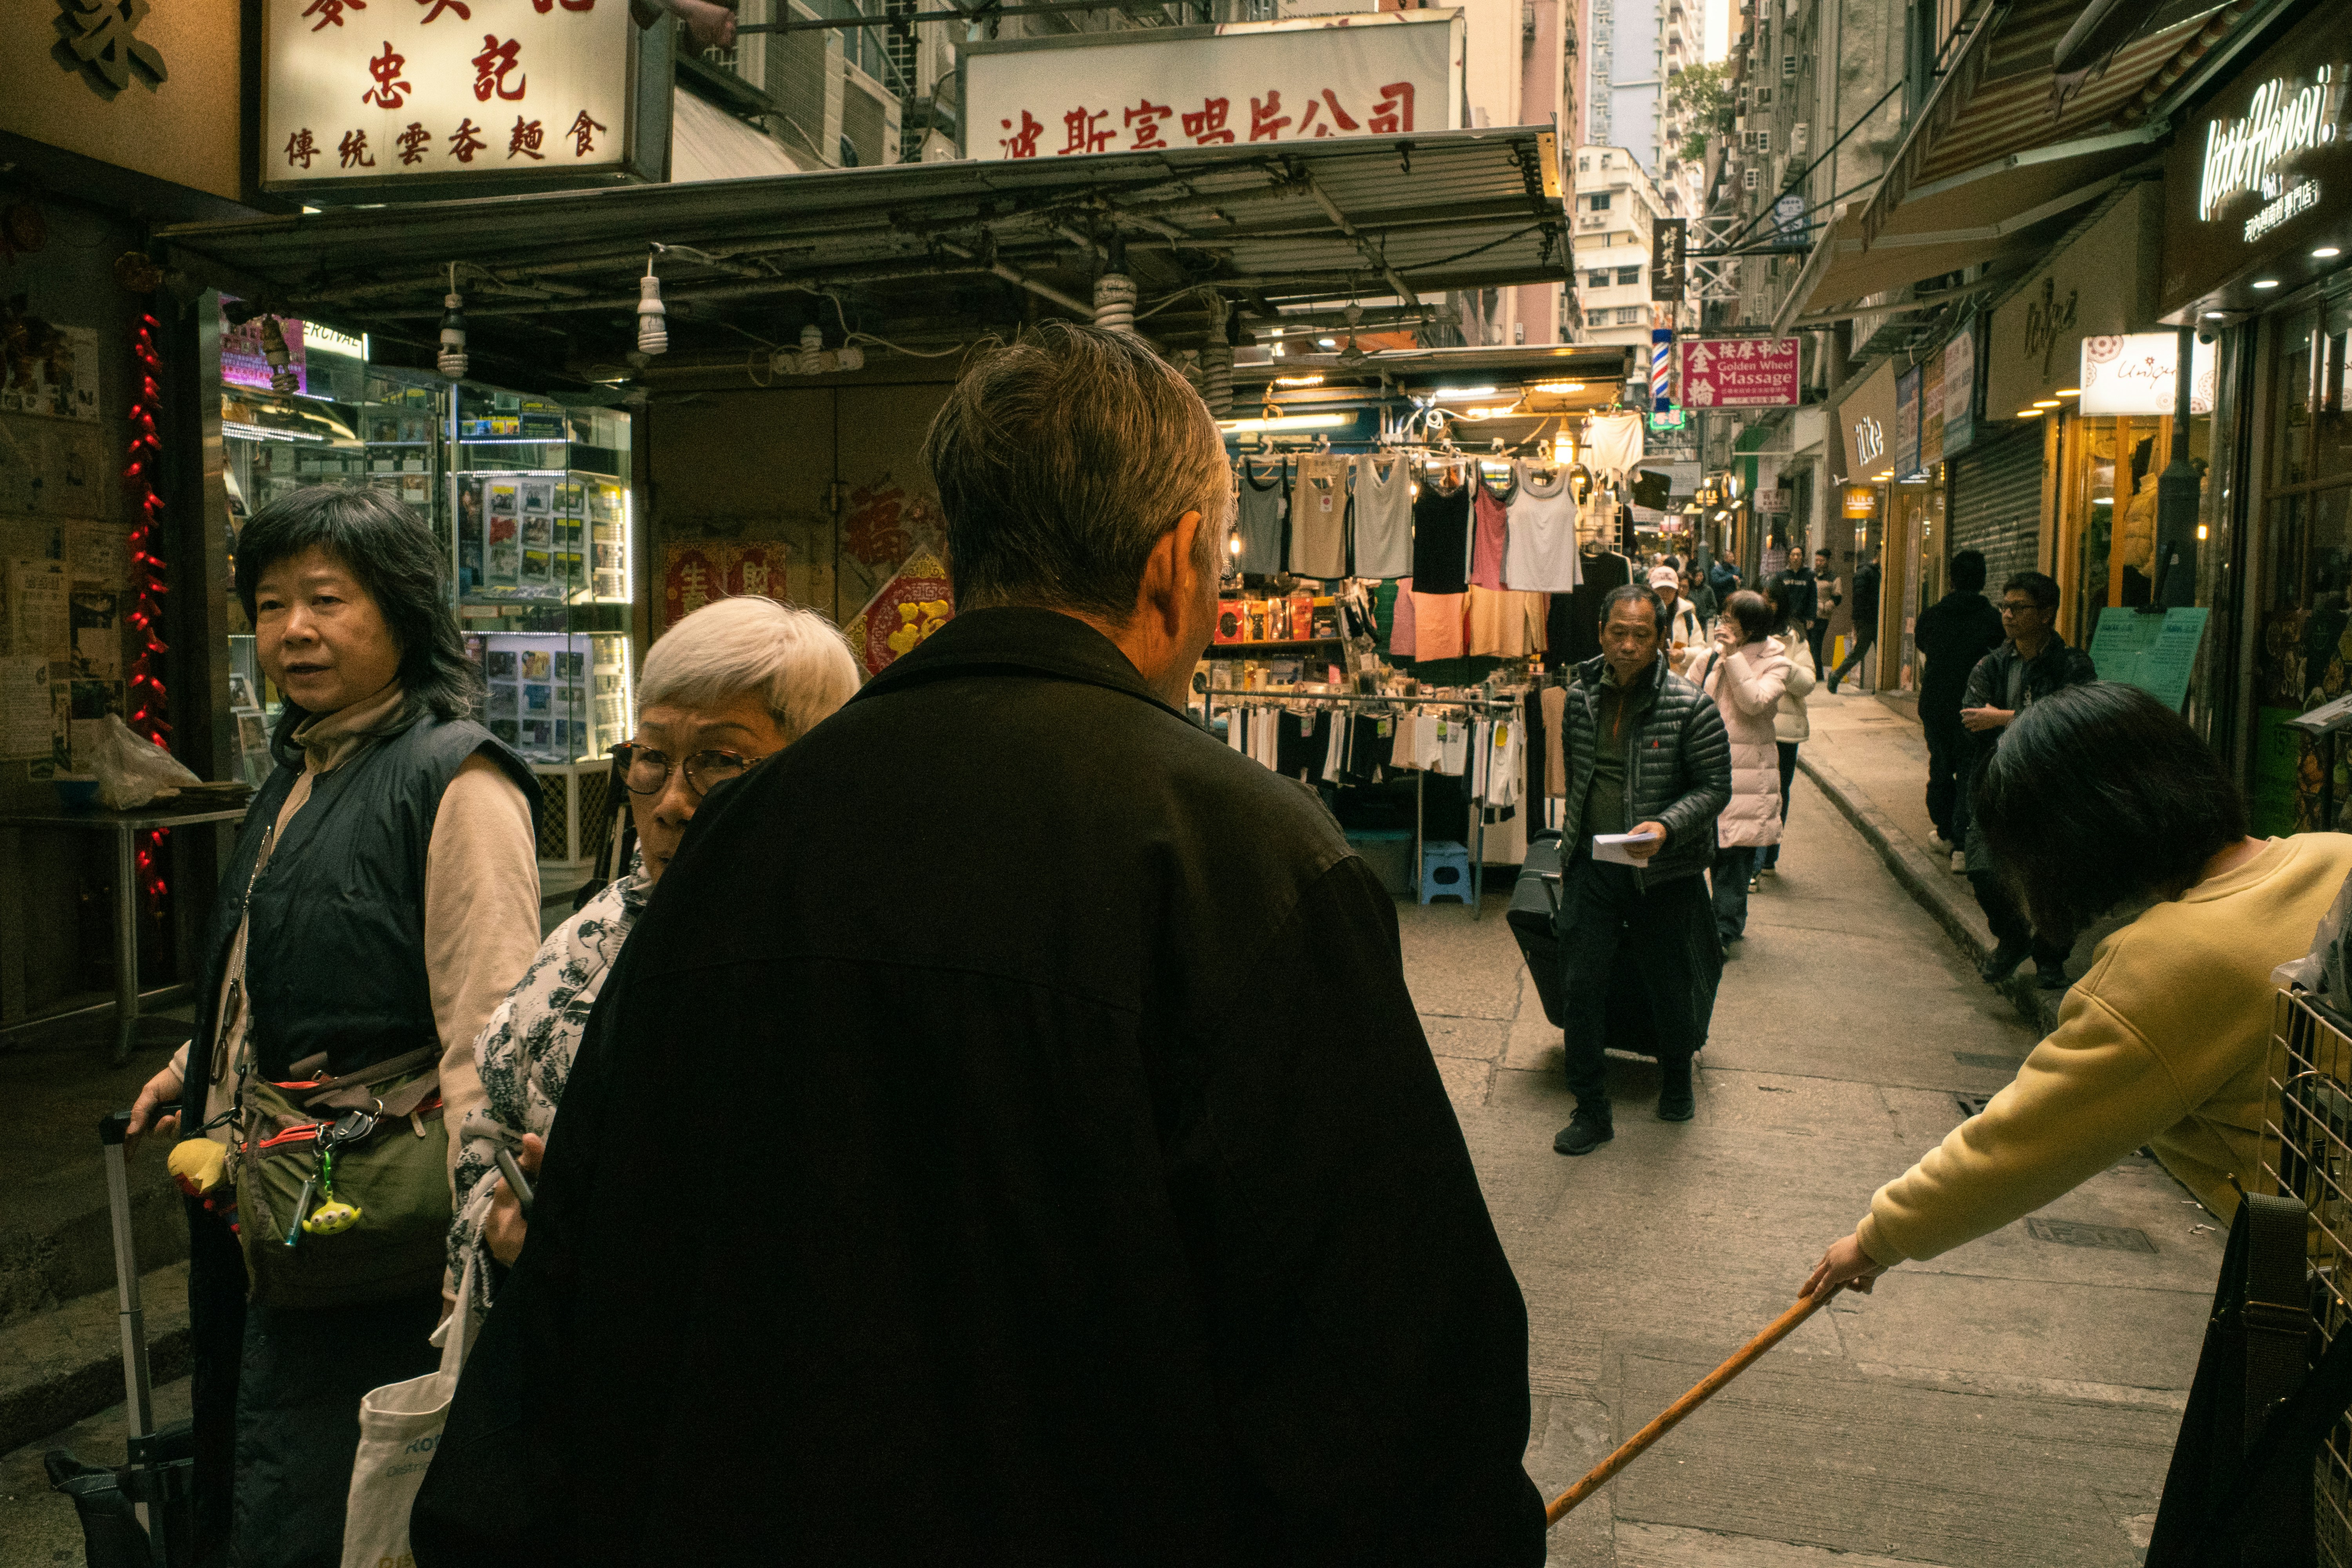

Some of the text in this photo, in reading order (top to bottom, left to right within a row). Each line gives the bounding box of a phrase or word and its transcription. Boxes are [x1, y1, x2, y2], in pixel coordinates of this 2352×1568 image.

[363, 34, 526, 109] 忠記
[284, 110, 607, 169] 傳統雲吞麵食
[1717, 361, 1793, 371] Golden Wheel
[1719, 340, 1793, 360] 按摩中心
[1687, 342, 1716, 407] 金輪
[1719, 372, 1792, 386] Massage
